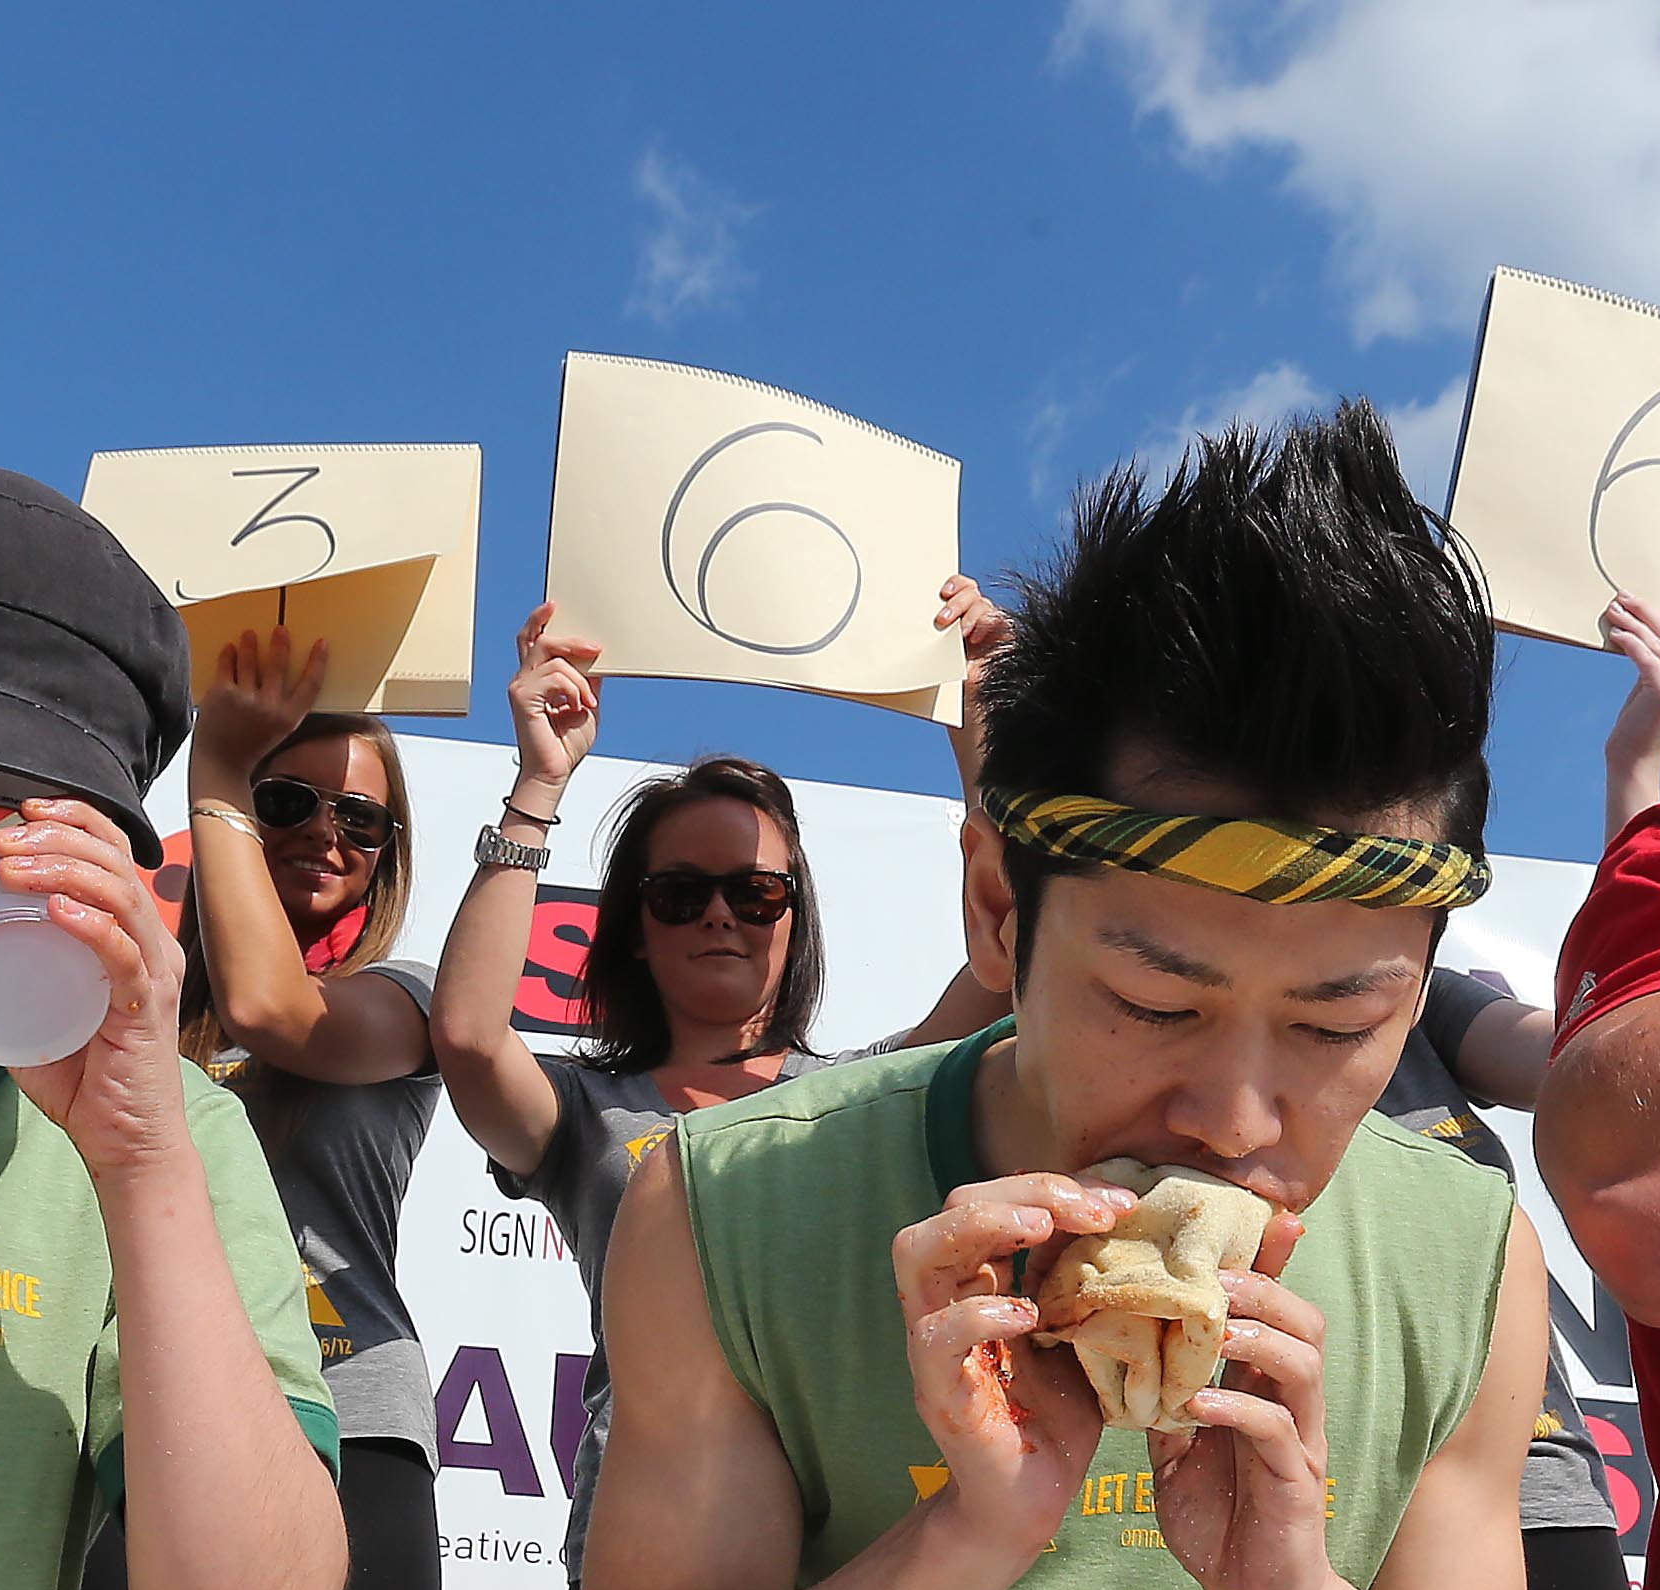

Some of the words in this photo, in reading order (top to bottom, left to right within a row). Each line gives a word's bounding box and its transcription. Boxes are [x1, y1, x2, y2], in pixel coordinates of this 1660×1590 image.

[175, 466, 337, 602] 3
[659, 420, 861, 656] 6
[460, 1209, 536, 1258] SIGN
[1081, 1473, 1128, 1516] LET
